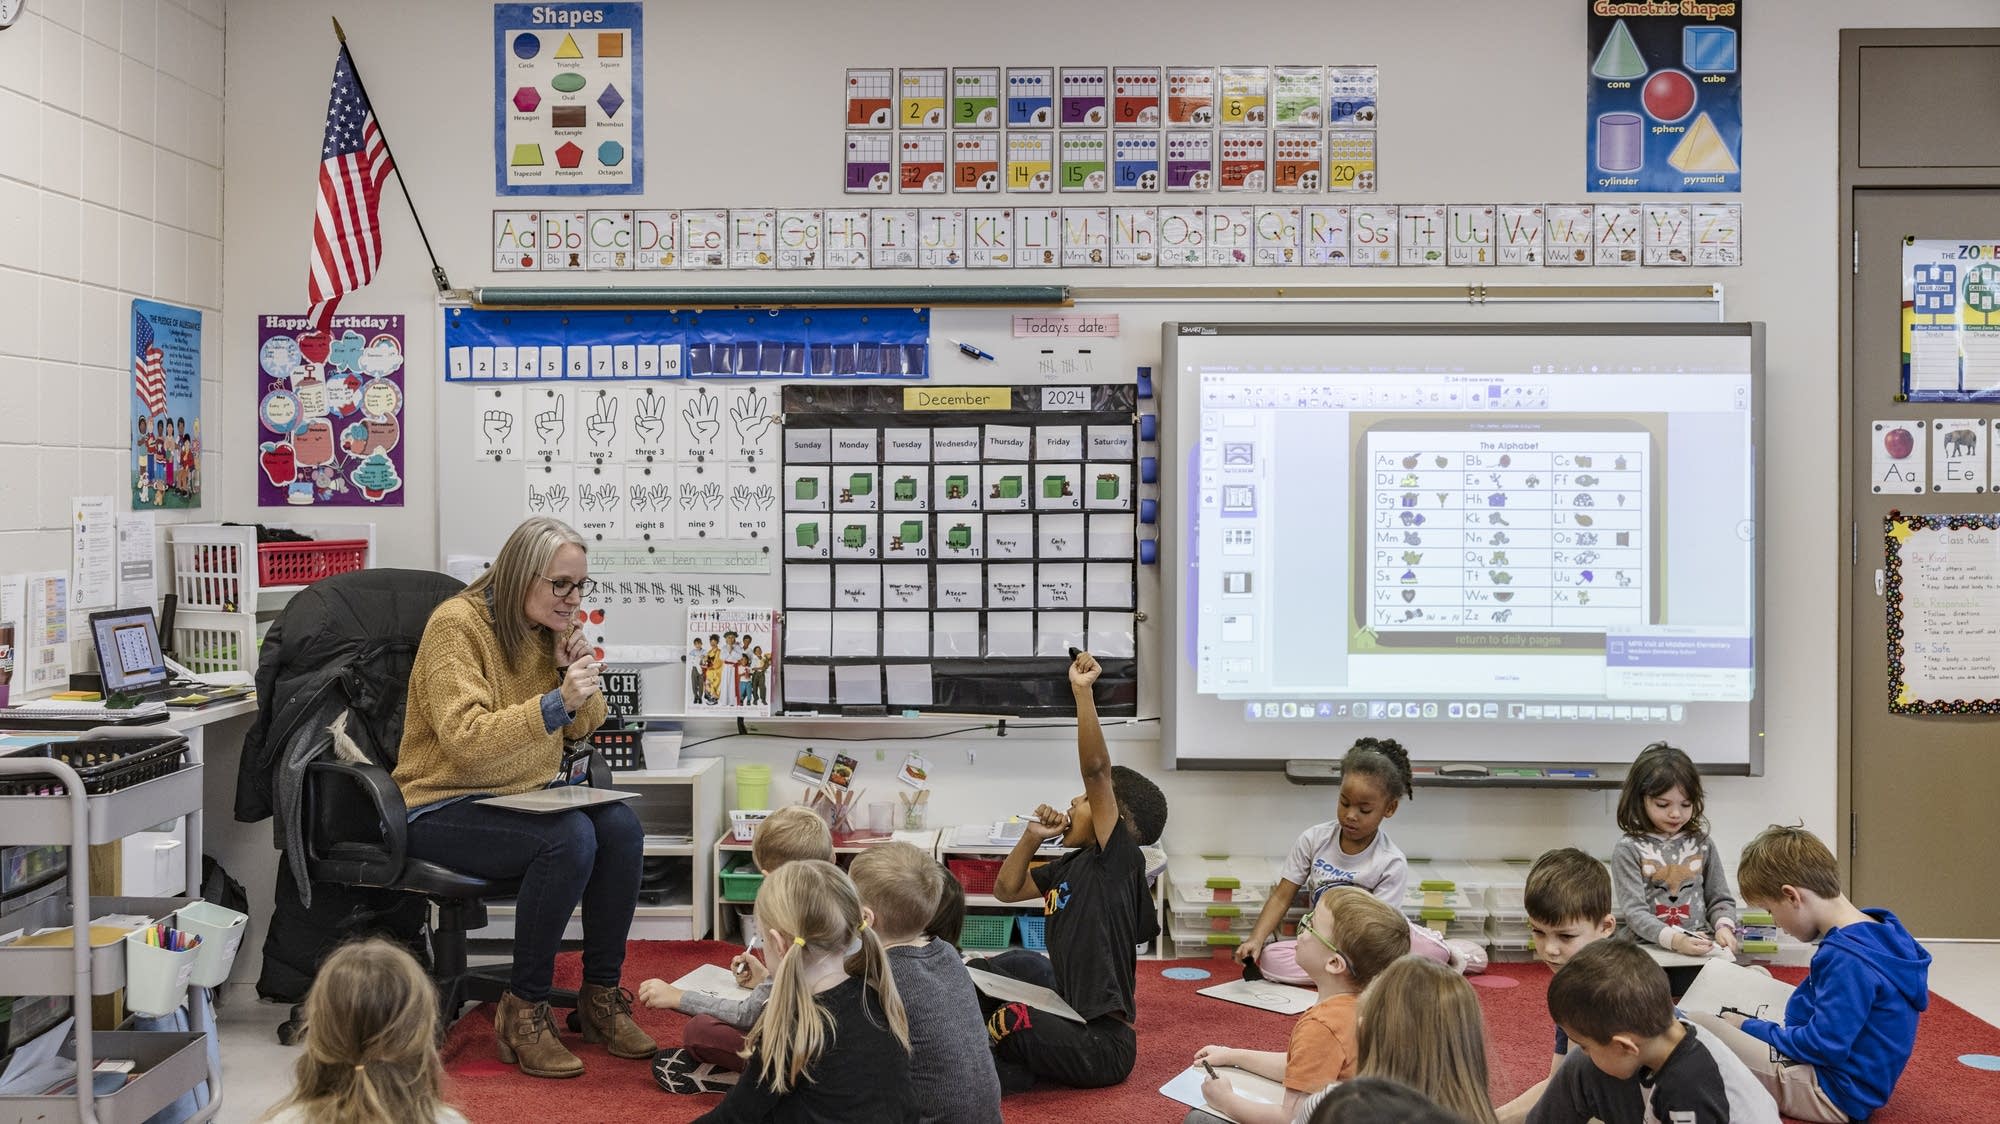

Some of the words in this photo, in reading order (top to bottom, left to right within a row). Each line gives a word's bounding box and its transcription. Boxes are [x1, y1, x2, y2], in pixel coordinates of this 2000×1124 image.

[532, 7, 604, 27] Shapes
[1594, 1, 1678, 16] Geometric
[1681, 1, 1735, 20] Shapes
[1702, 75, 1726, 83] cube
[910, 103, 920, 119] 2
[964, 102, 974, 118] 3
[1017, 102, 1026, 117] 4
[1072, 102, 1080, 117] 5
[1124, 102, 1134, 116] 6
[1231, 101, 1242, 116] 8
[1337, 102, 1353, 116] 10
[1652, 125, 1685, 134] sphere
[856, 167, 864, 182] 11
[961, 167, 976, 182] 13
[1015, 166, 1028, 182] 14
[1068, 166, 1083, 182] 15
[1122, 166, 1136, 181] 16
[1176, 166, 1188, 181] 17
[1334, 166, 1354, 181] 20
[1684, 176, 1724, 184] pyramid
[1598, 177, 1639, 186] cylinder
[266, 316, 316, 330] Happy
[1022, 318, 1069, 336] Today's
[480, 362, 486, 371] 2
[502, 362, 508, 371] 3
[525, 362, 531, 370] 4
[548, 362, 554, 370] 5
[574, 362, 580, 370] 6
[598, 362, 604, 370] 7
[622, 361, 628, 370] 8
[645, 361, 651, 369] 9
[666, 360, 676, 368] 10
[919, 392, 990, 406] December
[1048, 390, 1086, 404] 2024
[794, 442, 822, 450] Sunday
[840, 442, 869, 450] Monday
[892, 441, 922, 450] Tuesday
[936, 440, 978, 448] Wednesday
[990, 438, 1024, 447] Thursday
[1048, 438, 1070, 446] Friday
[1094, 438, 1128, 446] Saturday
[1498, 442, 1538, 450] Alphabet
[1884, 464, 1915, 482] Aa
[1948, 462, 1974, 480] Ee
[636, 521, 658, 530] eight
[591, 552, 615, 570] days
[624, 552, 646, 566] have
[652, 556, 666, 566] we
[672, 552, 696, 566] been
[704, 556, 712, 566] in
[598, 675, 636, 692] ACH
[1314, 858, 1357, 880] SONIC
